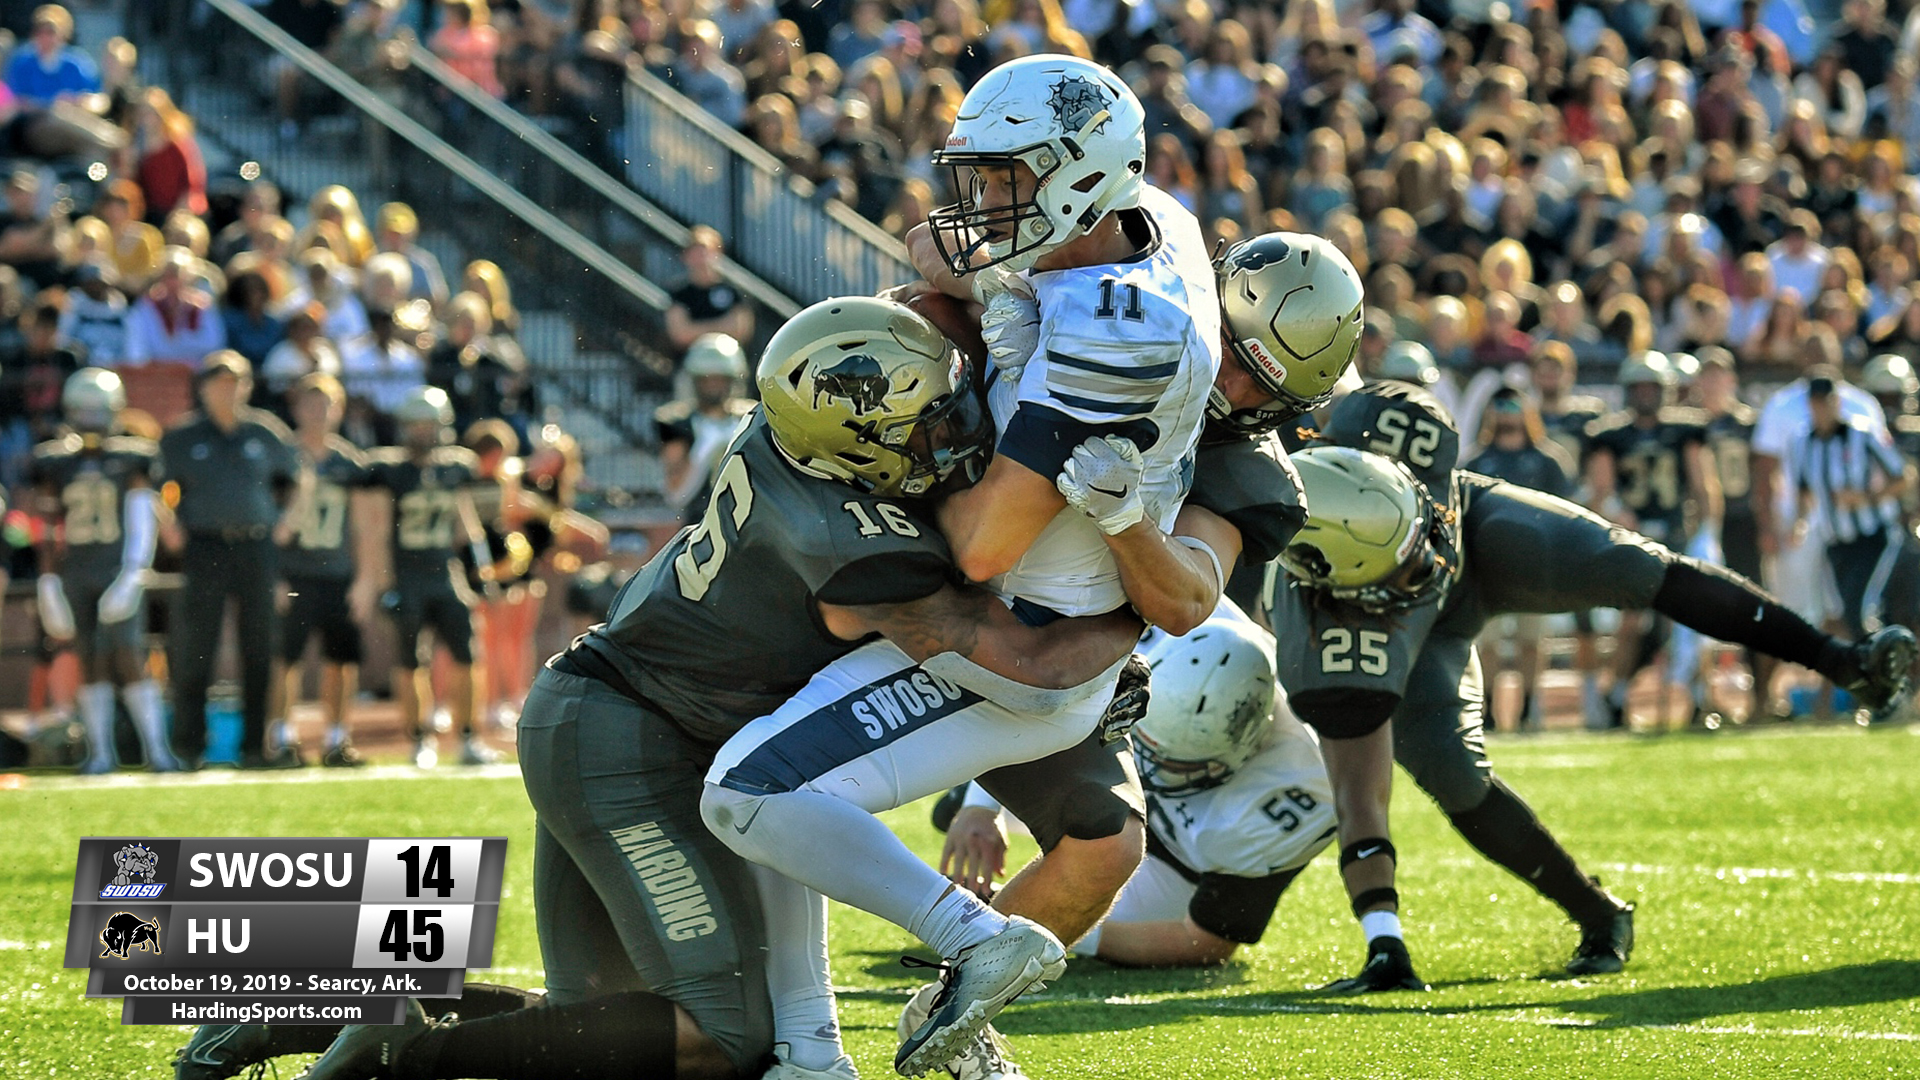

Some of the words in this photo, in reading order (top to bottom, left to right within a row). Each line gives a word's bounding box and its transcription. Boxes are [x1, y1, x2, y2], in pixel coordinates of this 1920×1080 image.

[1094, 279, 1147, 324] 11
[1249, 343, 1284, 379] Riddell
[844, 501, 920, 538] 16
[1321, 628, 1389, 676] 25
[851, 672, 962, 740] SWOSU
[609, 821, 718, 942] HARDING
